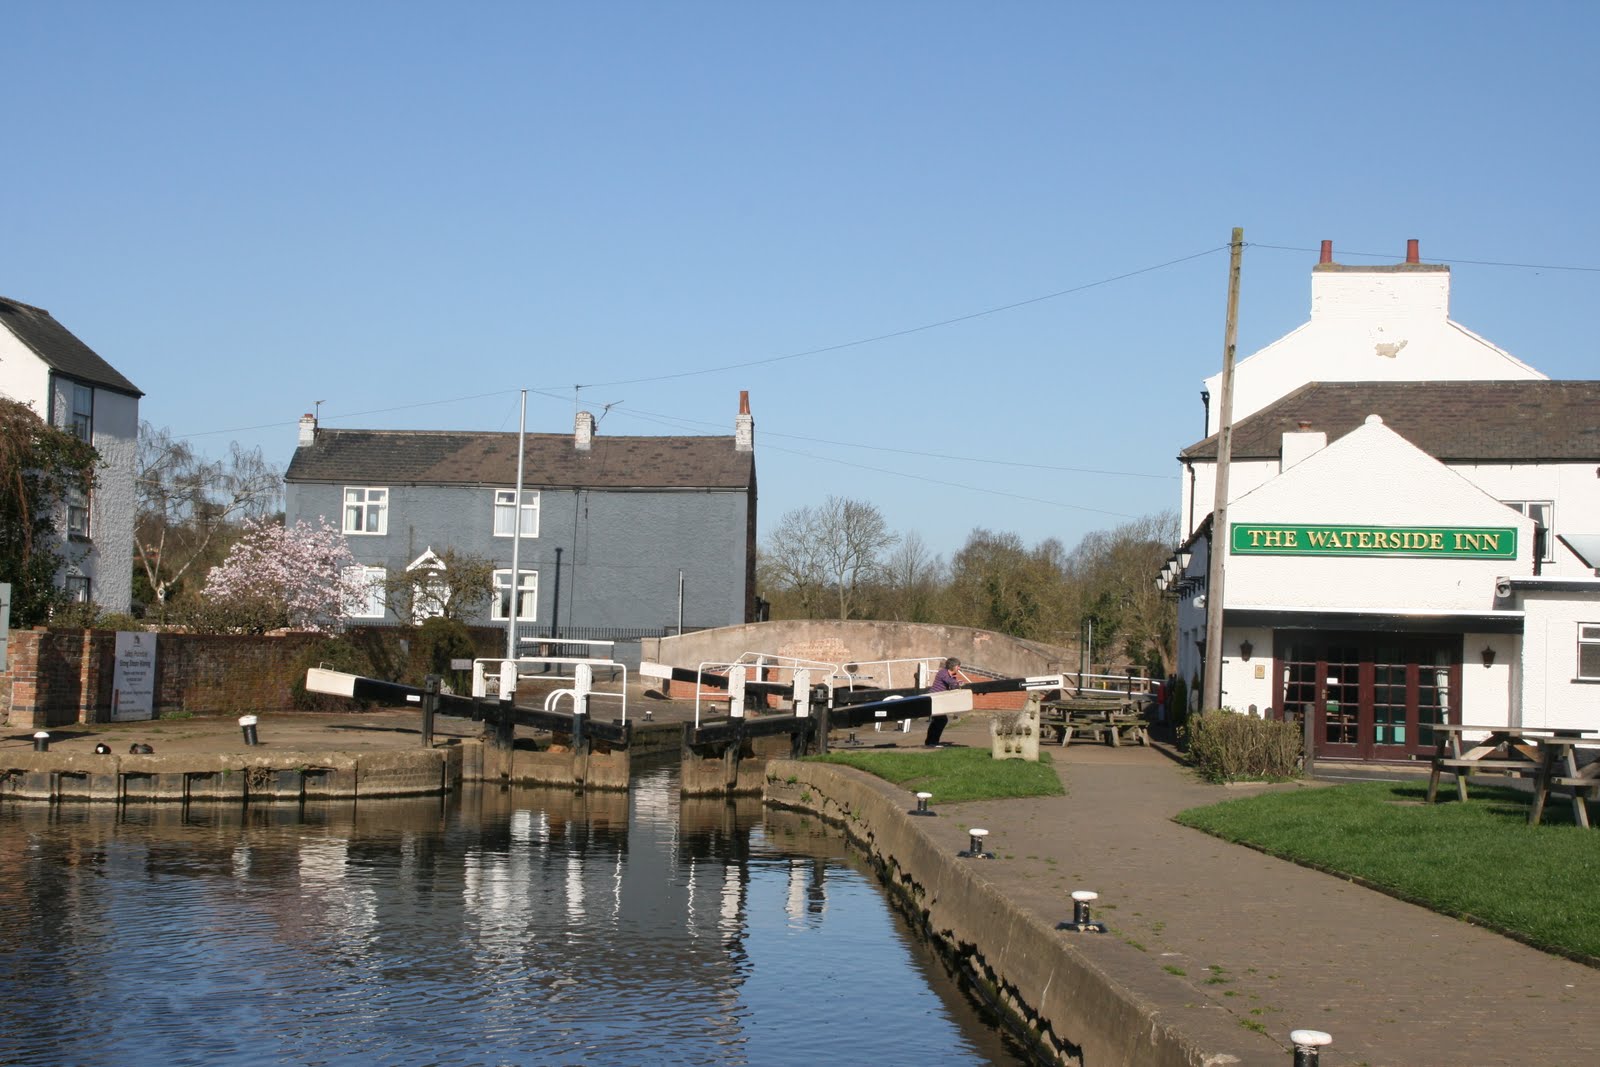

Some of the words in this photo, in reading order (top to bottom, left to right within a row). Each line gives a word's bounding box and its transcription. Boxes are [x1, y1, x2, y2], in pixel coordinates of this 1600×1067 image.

[1248, 530, 1298, 547] THE
[1307, 531, 1444, 549] WATERSIDE
[1453, 533, 1500, 551] INN
